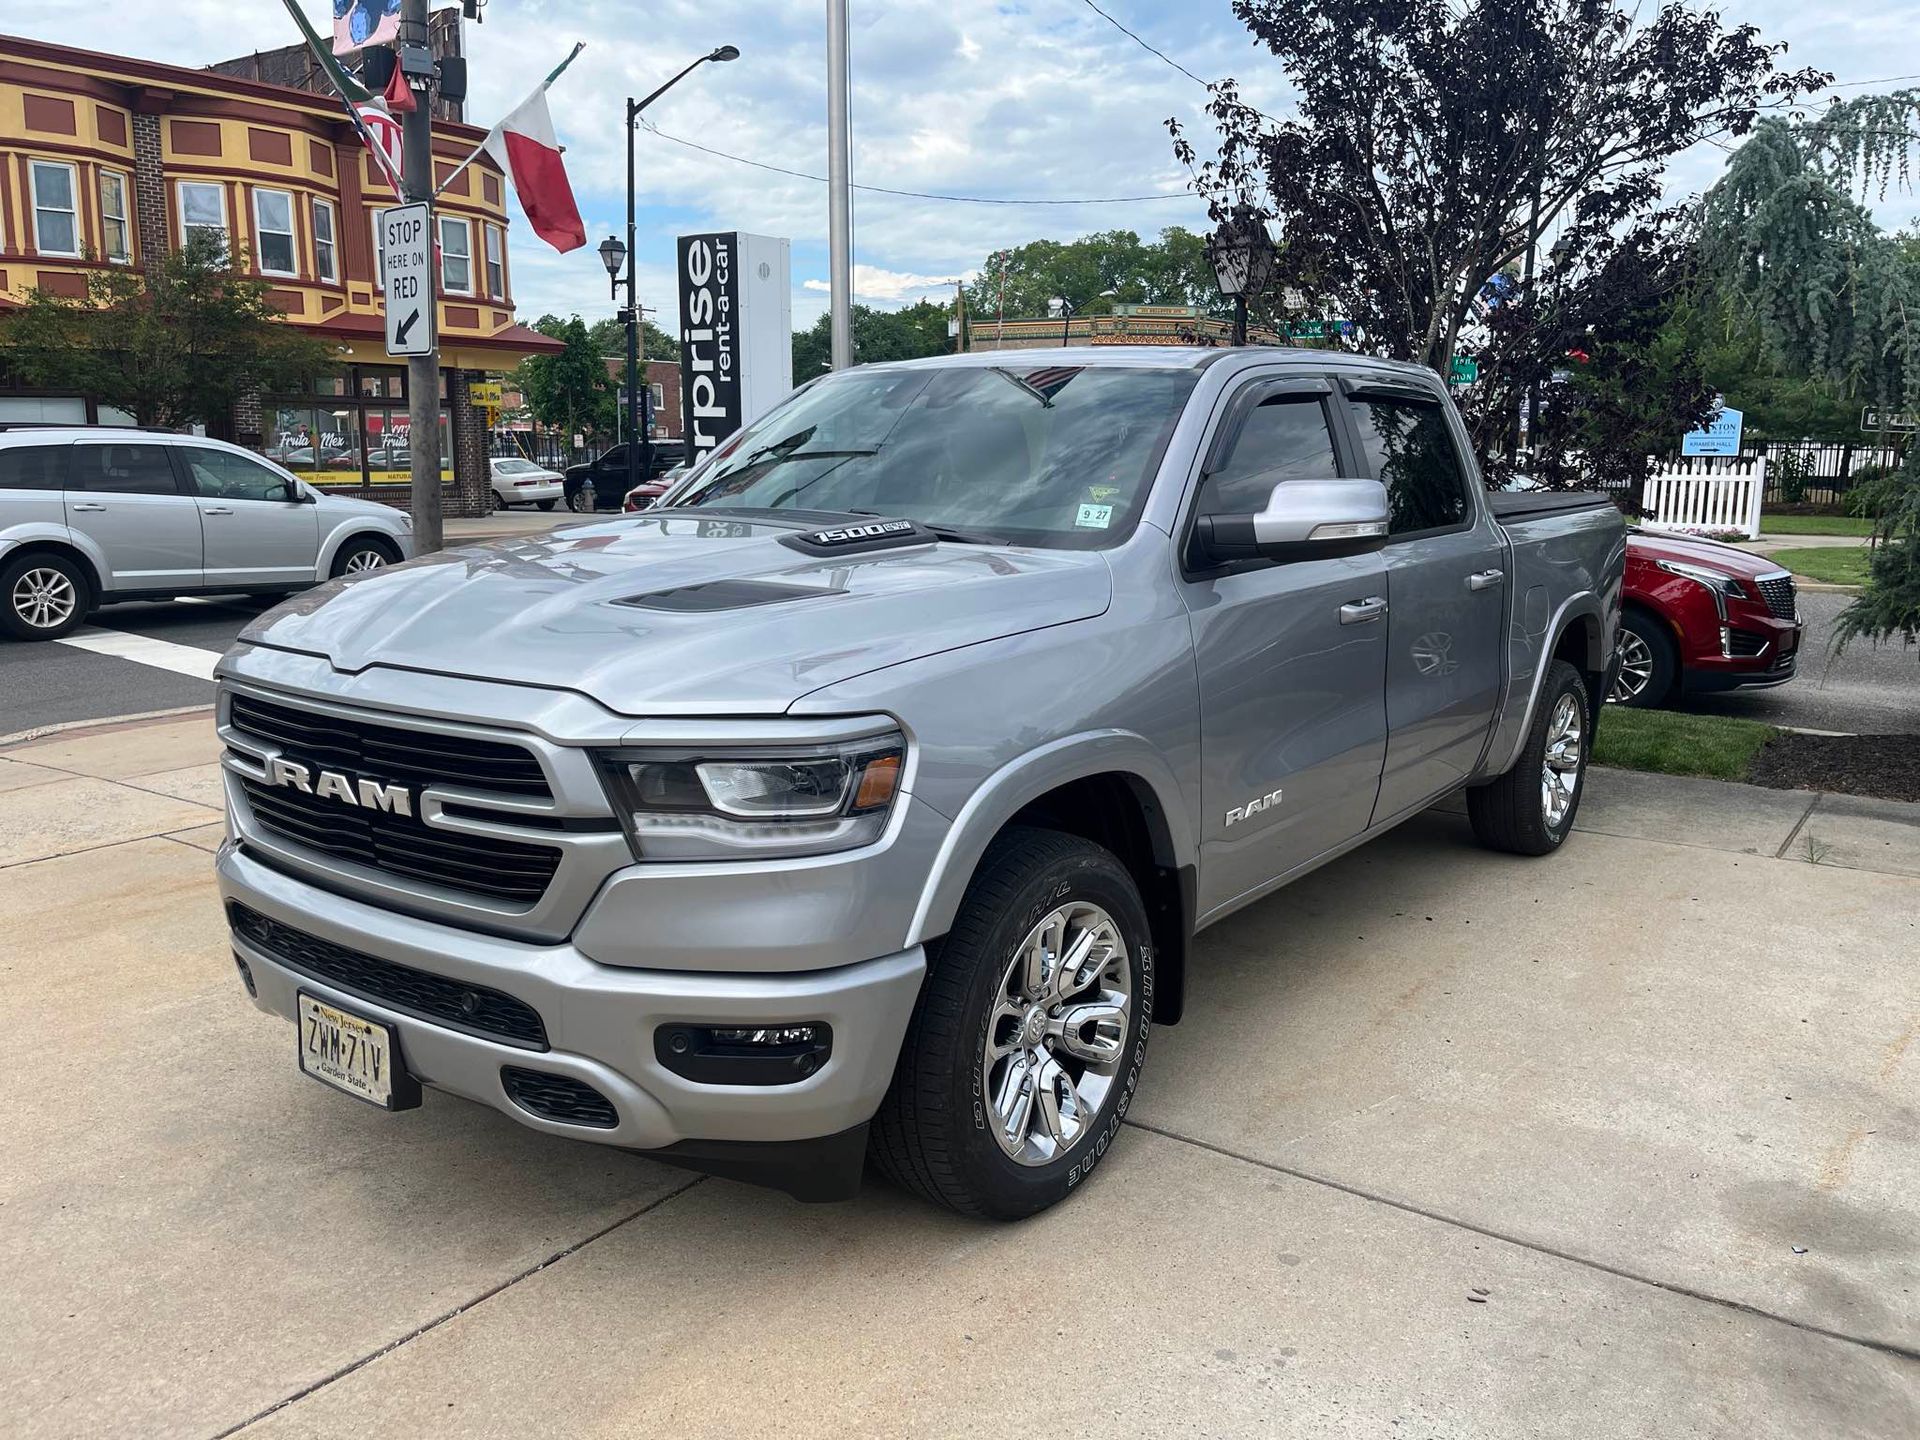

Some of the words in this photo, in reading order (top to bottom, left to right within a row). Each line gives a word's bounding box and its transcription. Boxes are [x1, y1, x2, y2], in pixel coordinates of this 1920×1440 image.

[388, 219, 422, 246] STOP
[387, 253, 408, 269] HERE
[412, 252, 424, 267] ON
[394, 275, 418, 300] RED
[715, 238, 732, 383] rent-a-car
[684, 239, 727, 465] rprise
[279, 432, 310, 448] Fruta
[320, 432, 345, 449] Mex
[380, 433, 410, 448] Fruta
[1083, 510, 1091, 519] 9
[1095, 510, 1108, 520] 27
[814, 524, 885, 543] 1500
[272, 756, 412, 817] RAM
[1225, 789, 1283, 828] RAM
[320, 1006, 338, 1023] New
[340, 1015, 364, 1036] Jersey
[321, 1062, 346, 1080] Garden
[347, 1073, 367, 1089] State
